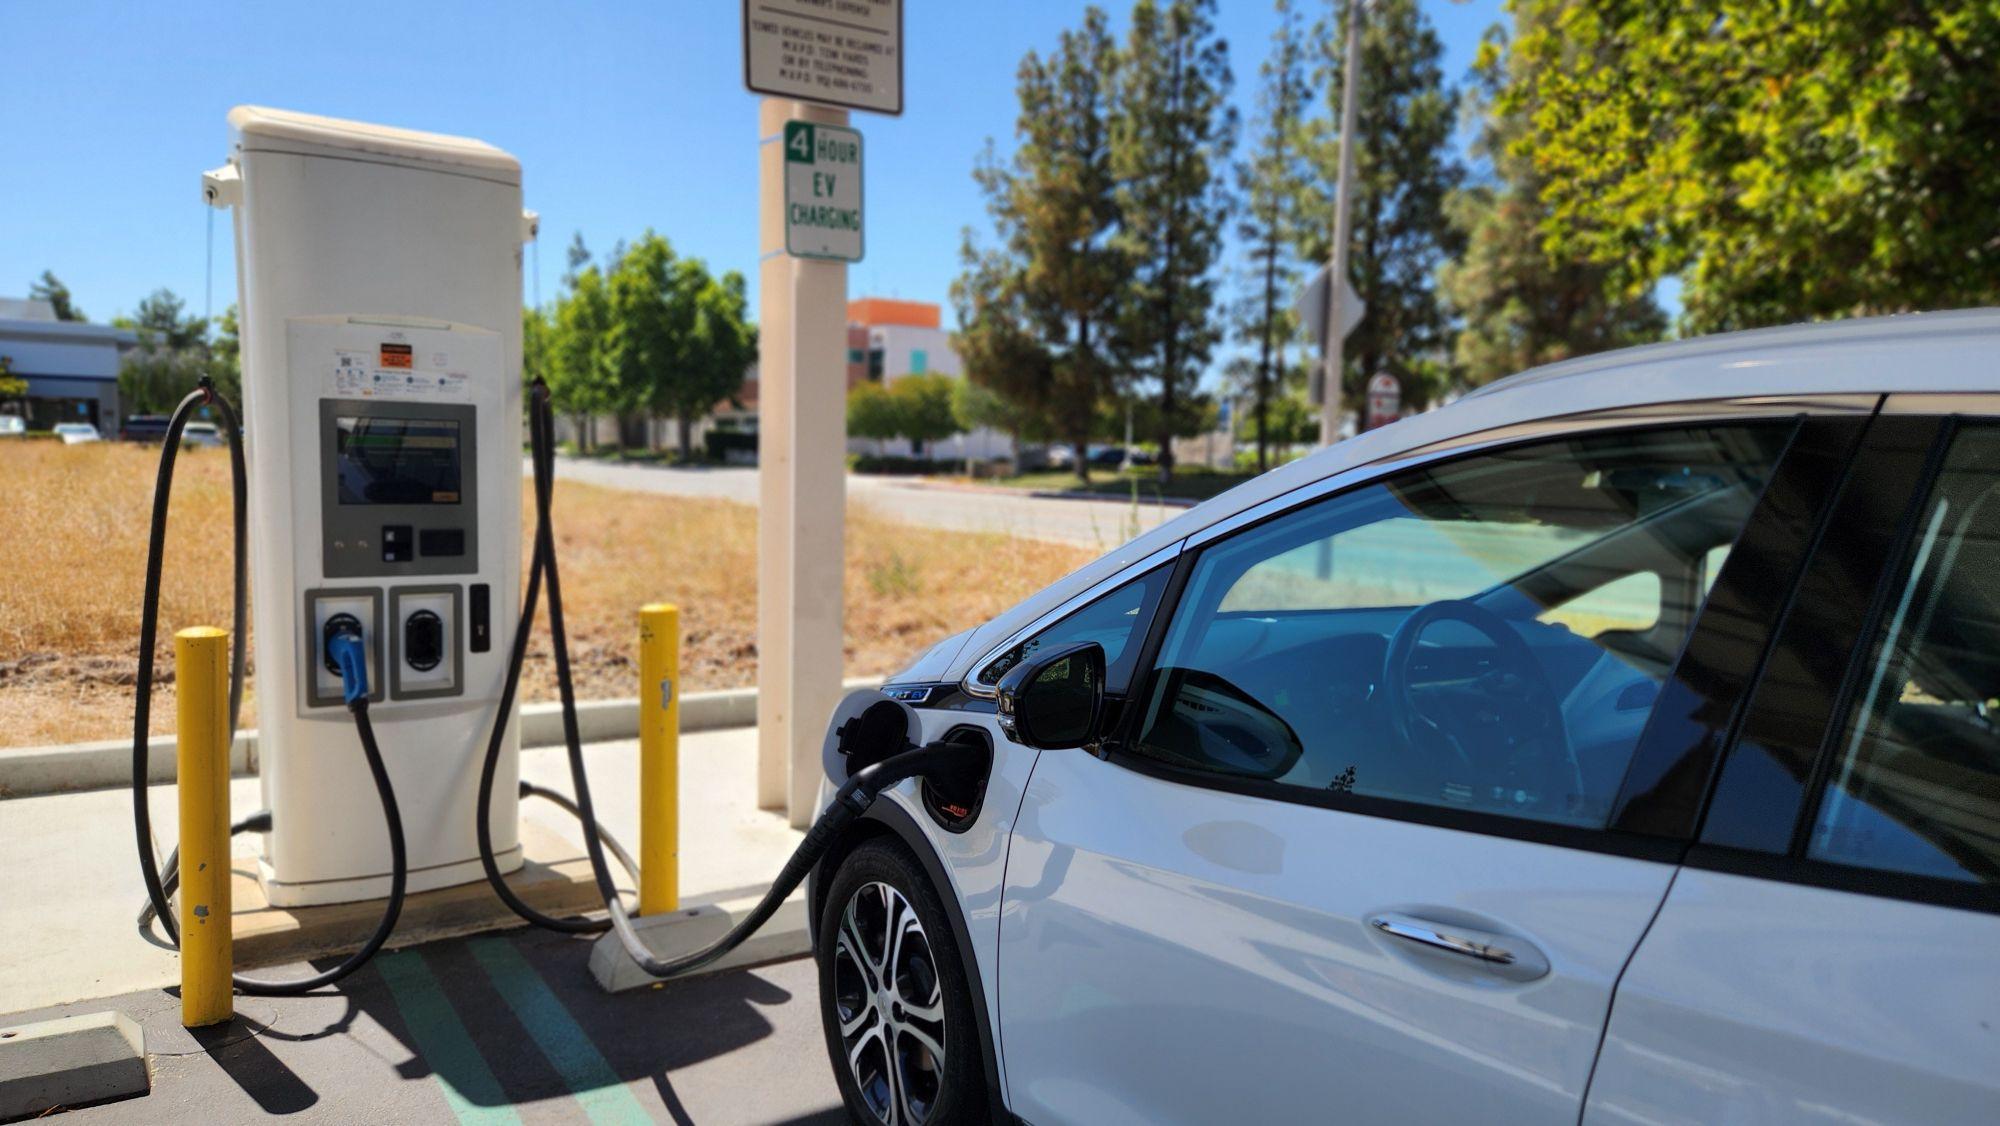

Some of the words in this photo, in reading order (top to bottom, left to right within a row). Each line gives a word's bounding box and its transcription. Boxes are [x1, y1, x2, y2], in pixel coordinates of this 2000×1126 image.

[752, 19, 779, 34] TOWED
[782, 25, 814, 41] VEHICLES
[817, 33, 832, 43] MAY
[835, 36, 844, 46] BE
[782, 53, 795, 66] OR
[798, 56, 810, 68] BY
[819, 46, 839, 59] TOW
[842, 51, 869, 66] YARDS
[789, 126, 809, 158] 4
[817, 138, 857, 164] HOUR
[813, 172, 836, 198] EV
[790, 203, 859, 232] CHARGING
